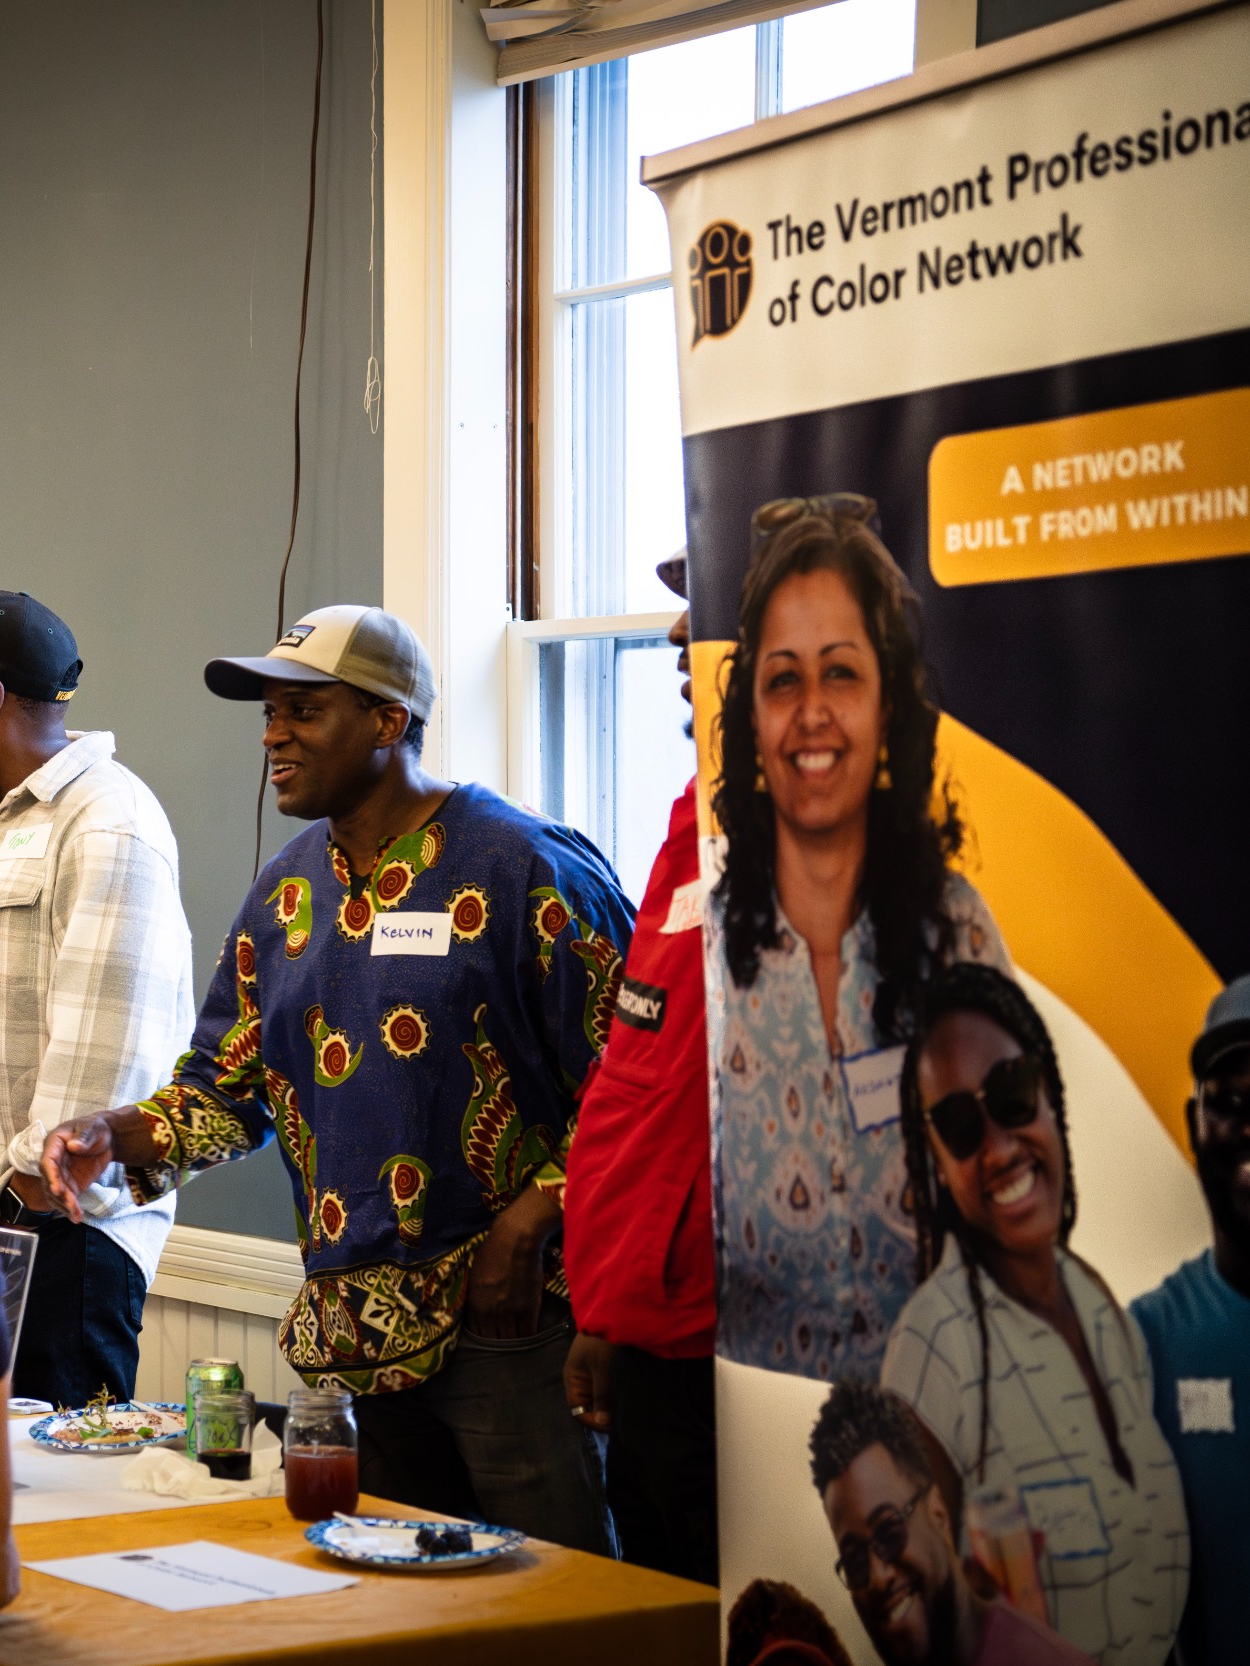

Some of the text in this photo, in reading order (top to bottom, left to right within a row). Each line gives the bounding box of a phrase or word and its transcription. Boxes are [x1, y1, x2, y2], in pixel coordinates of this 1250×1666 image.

[766, 213, 826, 261] The
[835, 164, 993, 243] Vermont
[768, 211, 1084, 327] of Color Network
[1000, 439, 1186, 496] A NETWORK
[944, 484, 1249, 554] BUILT FROM WITHIN
